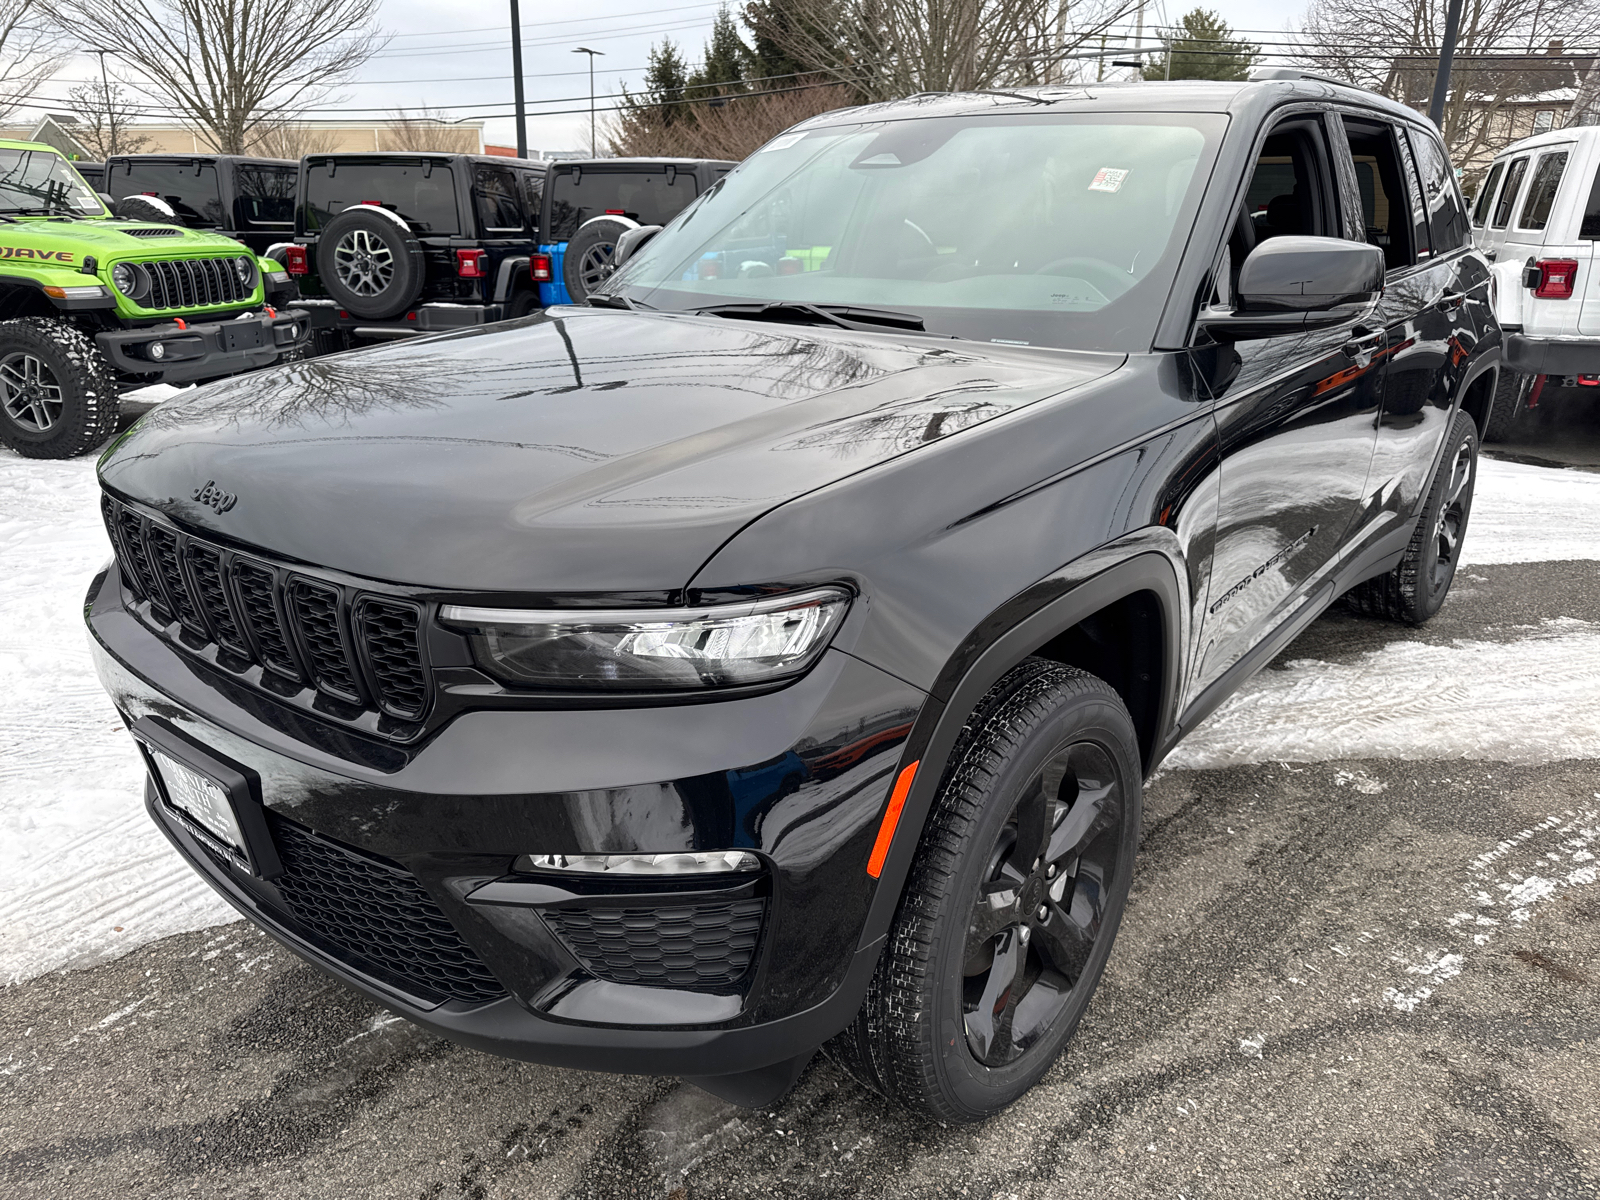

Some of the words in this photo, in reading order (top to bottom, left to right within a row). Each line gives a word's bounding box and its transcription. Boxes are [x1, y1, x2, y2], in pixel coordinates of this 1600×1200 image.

[0, 247, 74, 263] JAVE
[190, 480, 238, 516] Jeep
[161, 754, 217, 799] COLONIAL
[174, 774, 213, 809] SOUTH
